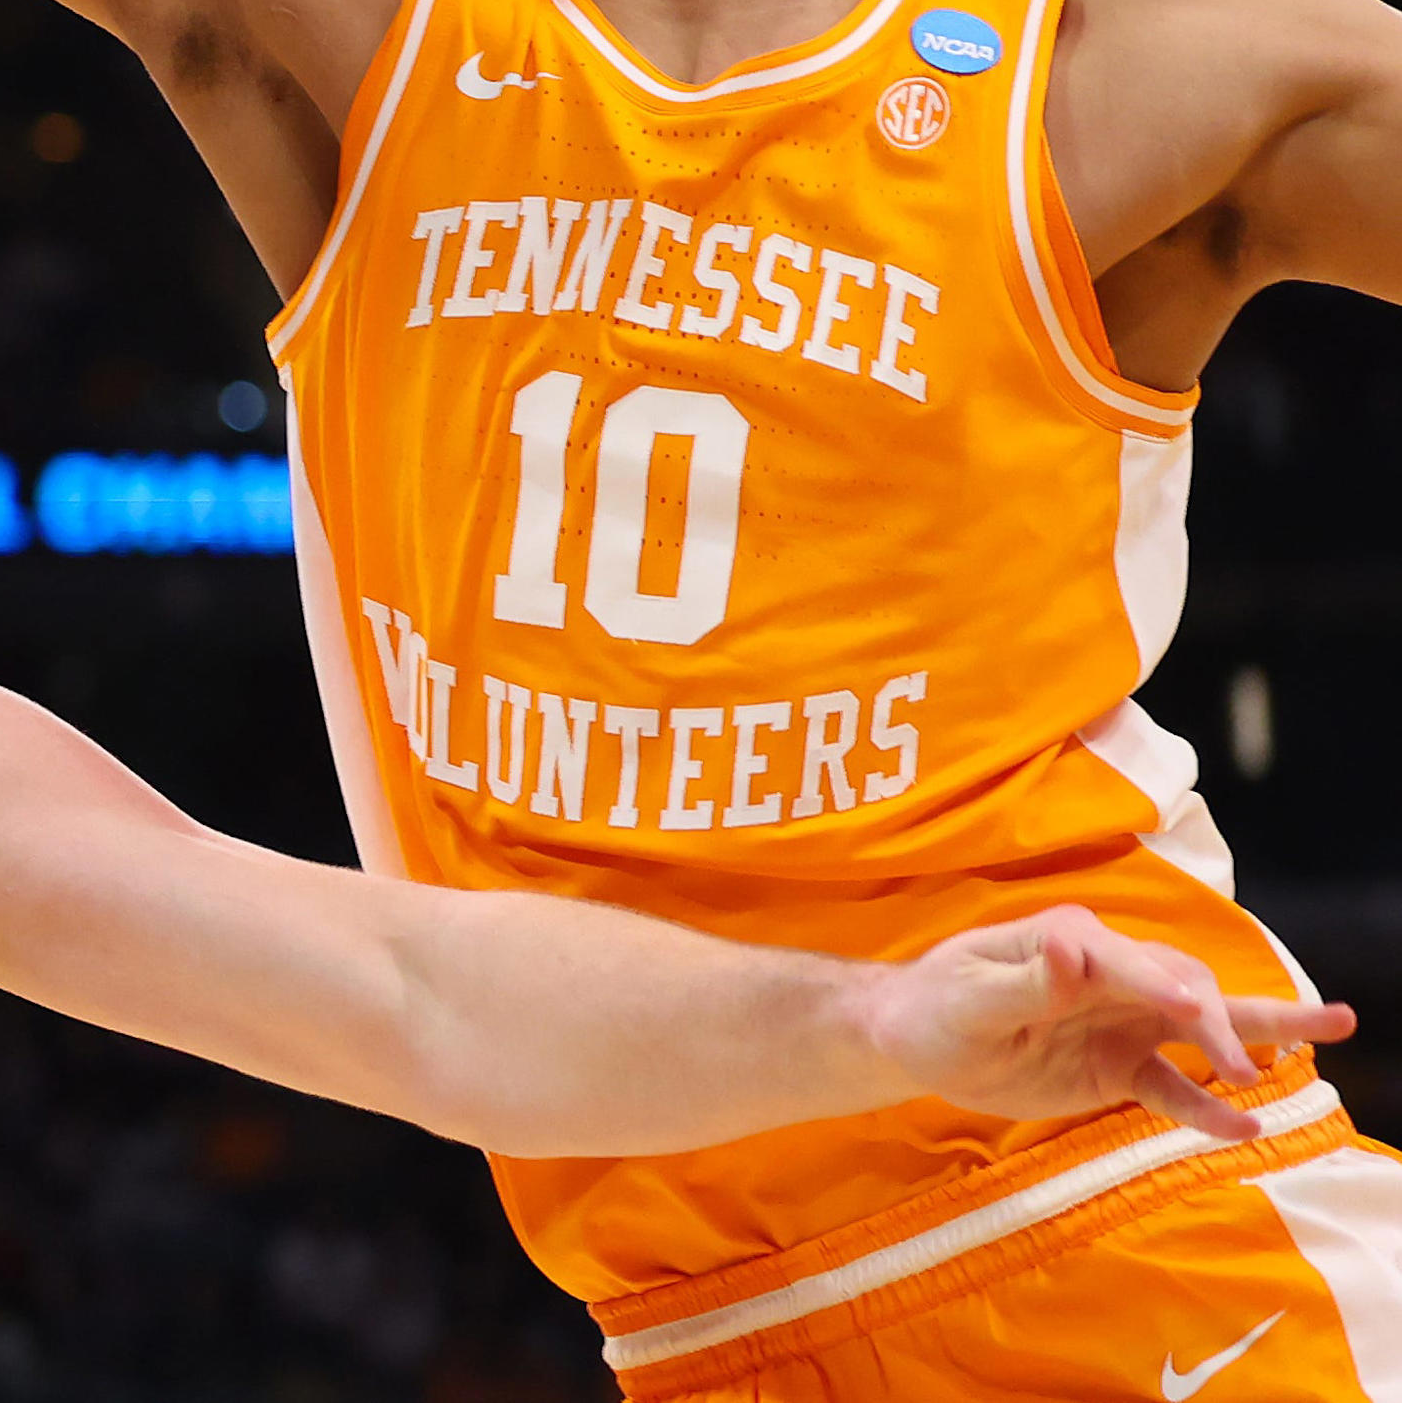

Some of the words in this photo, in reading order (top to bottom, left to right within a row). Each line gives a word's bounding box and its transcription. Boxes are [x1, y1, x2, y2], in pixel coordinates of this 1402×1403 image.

[883, 83, 944, 142] SEC
[921, 32, 996, 62] NCAA
[405, 195, 941, 404] TENNESSEE
[492, 369, 750, 646] 10
[360, 598, 929, 831] VOLUNTEERS
